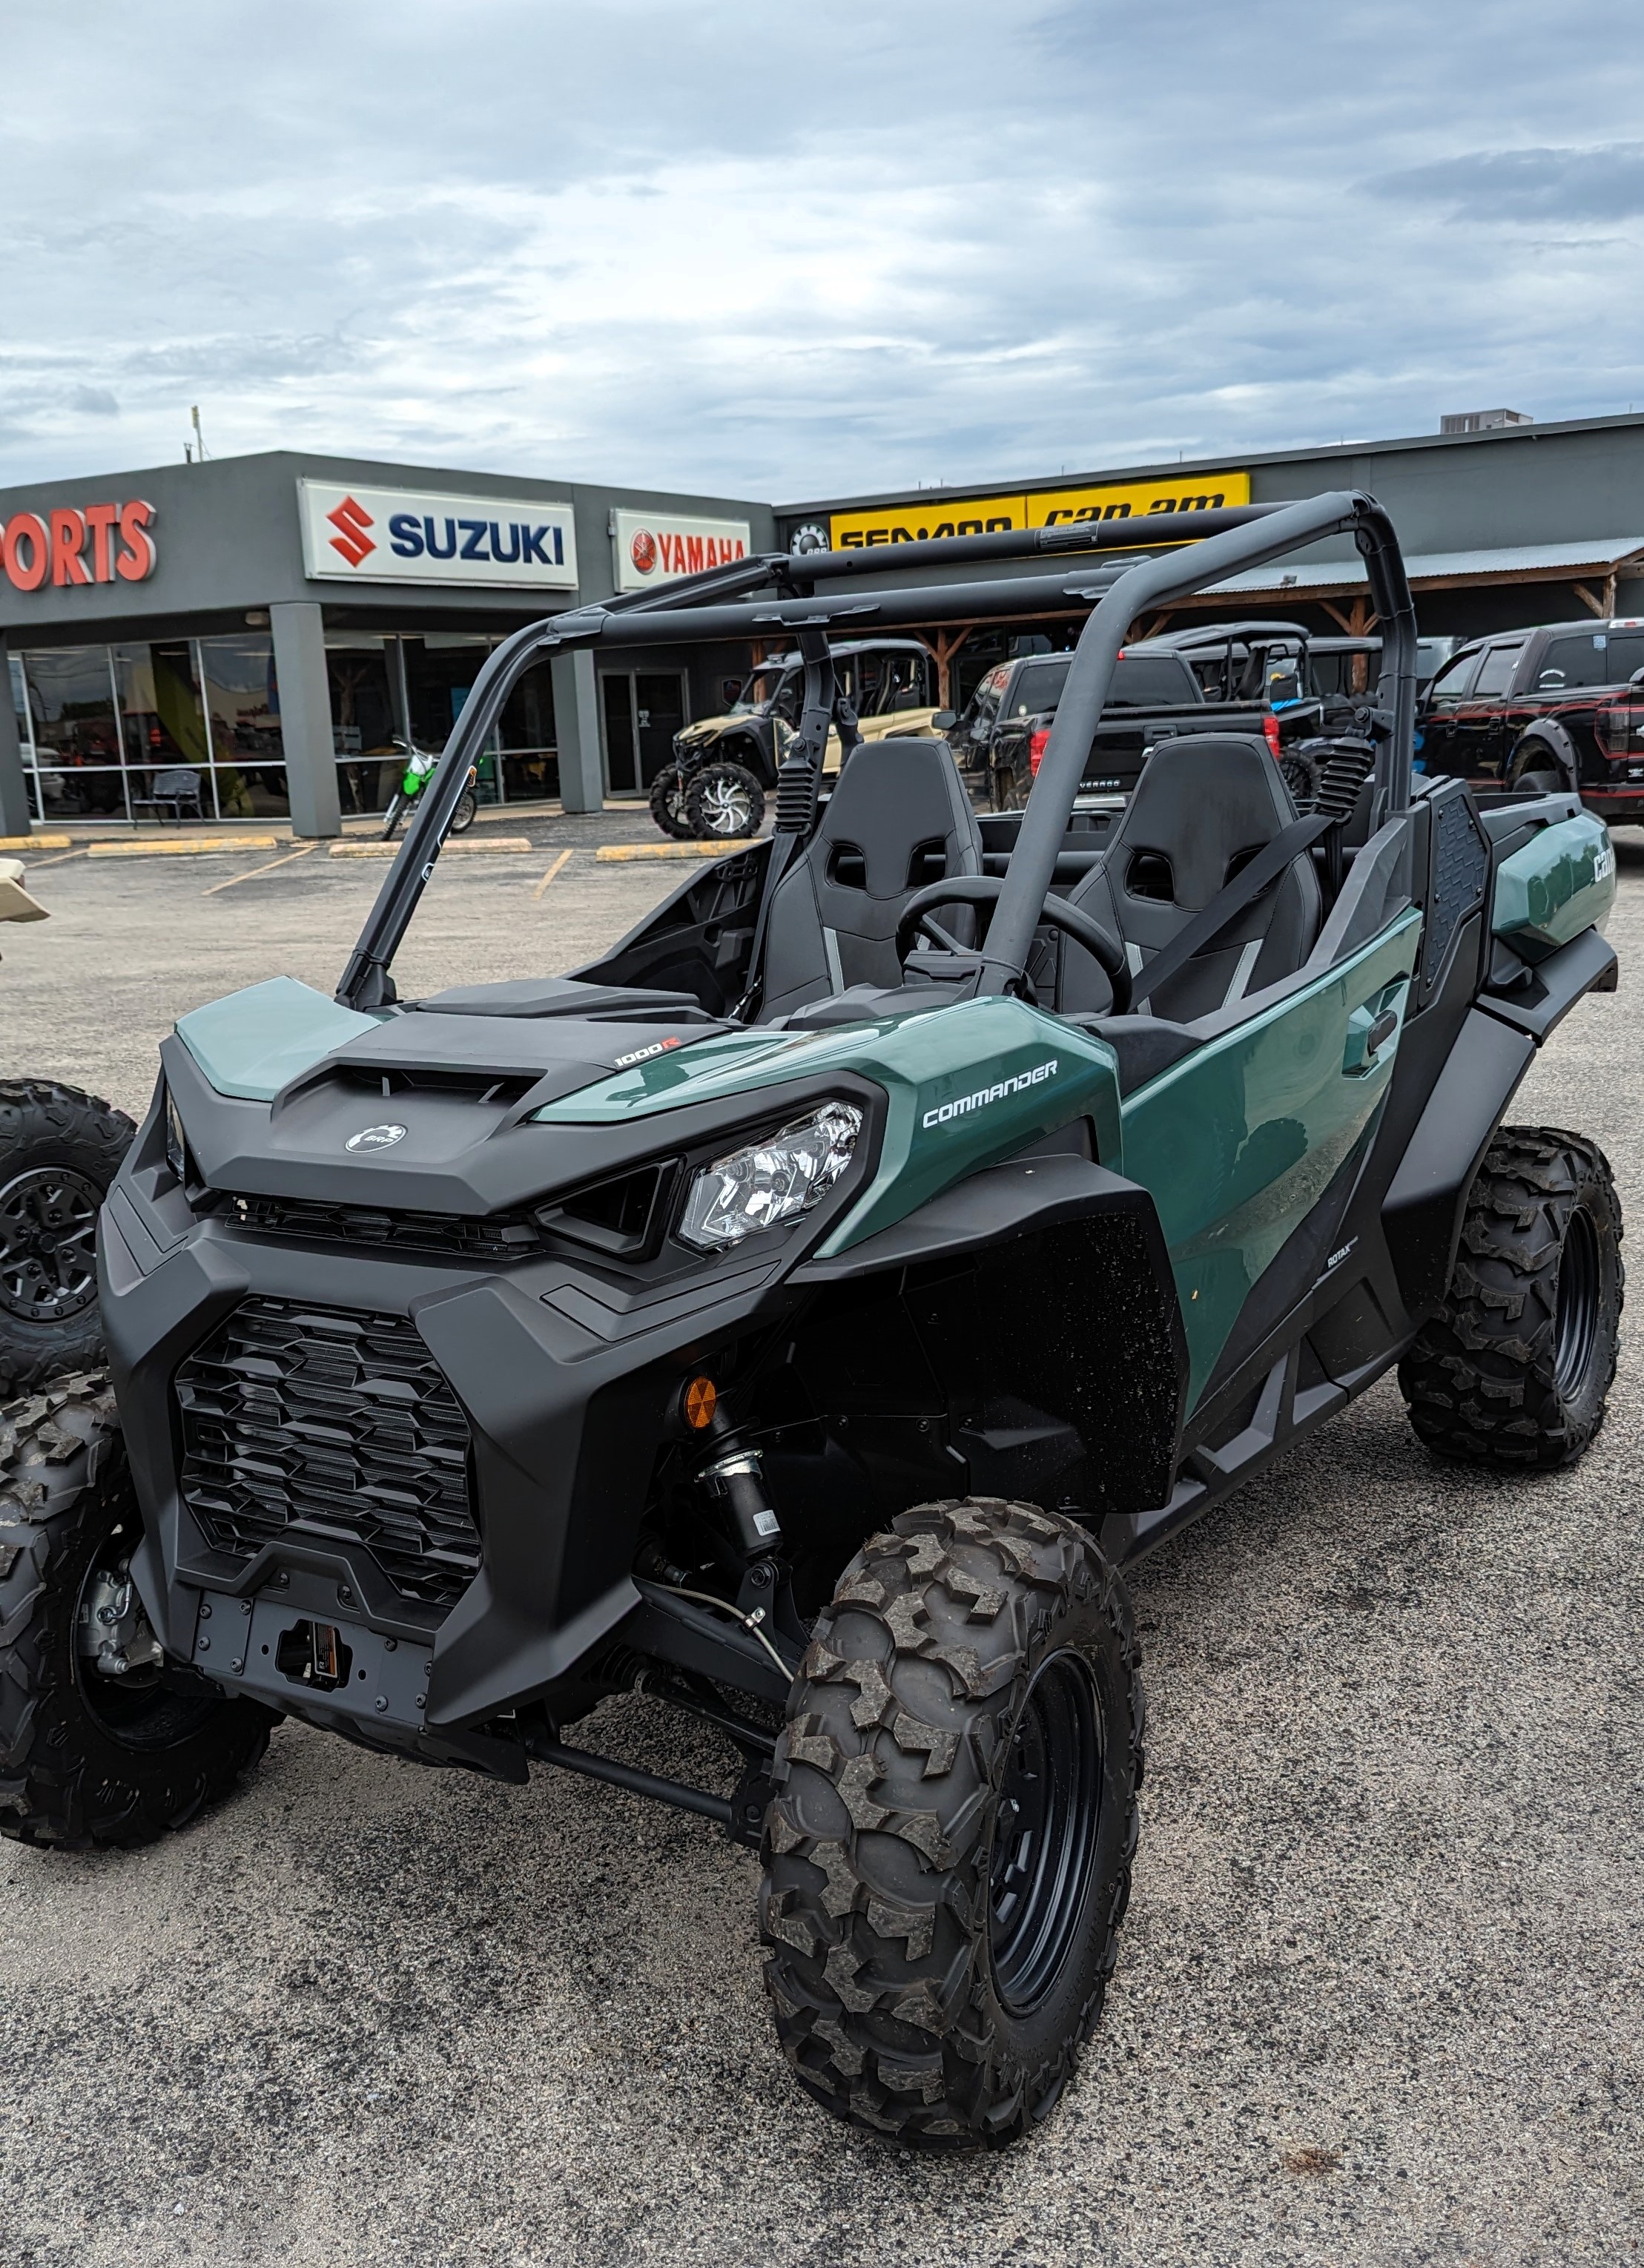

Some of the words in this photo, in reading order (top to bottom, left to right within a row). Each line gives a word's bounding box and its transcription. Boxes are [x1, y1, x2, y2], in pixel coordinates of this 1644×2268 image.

[0, 500, 157, 592] ORTS
[389, 513, 564, 566] SUZUKI
[657, 533, 745, 573] YAMAHA
[1079, 779, 1120, 788] VERADO
[614, 1038, 681, 1067] 1000R
[922, 1059, 1058, 1129] COMMANDER
[363, 1135, 394, 1143] BRP
[1327, 1245, 1351, 1268] ROTAX
